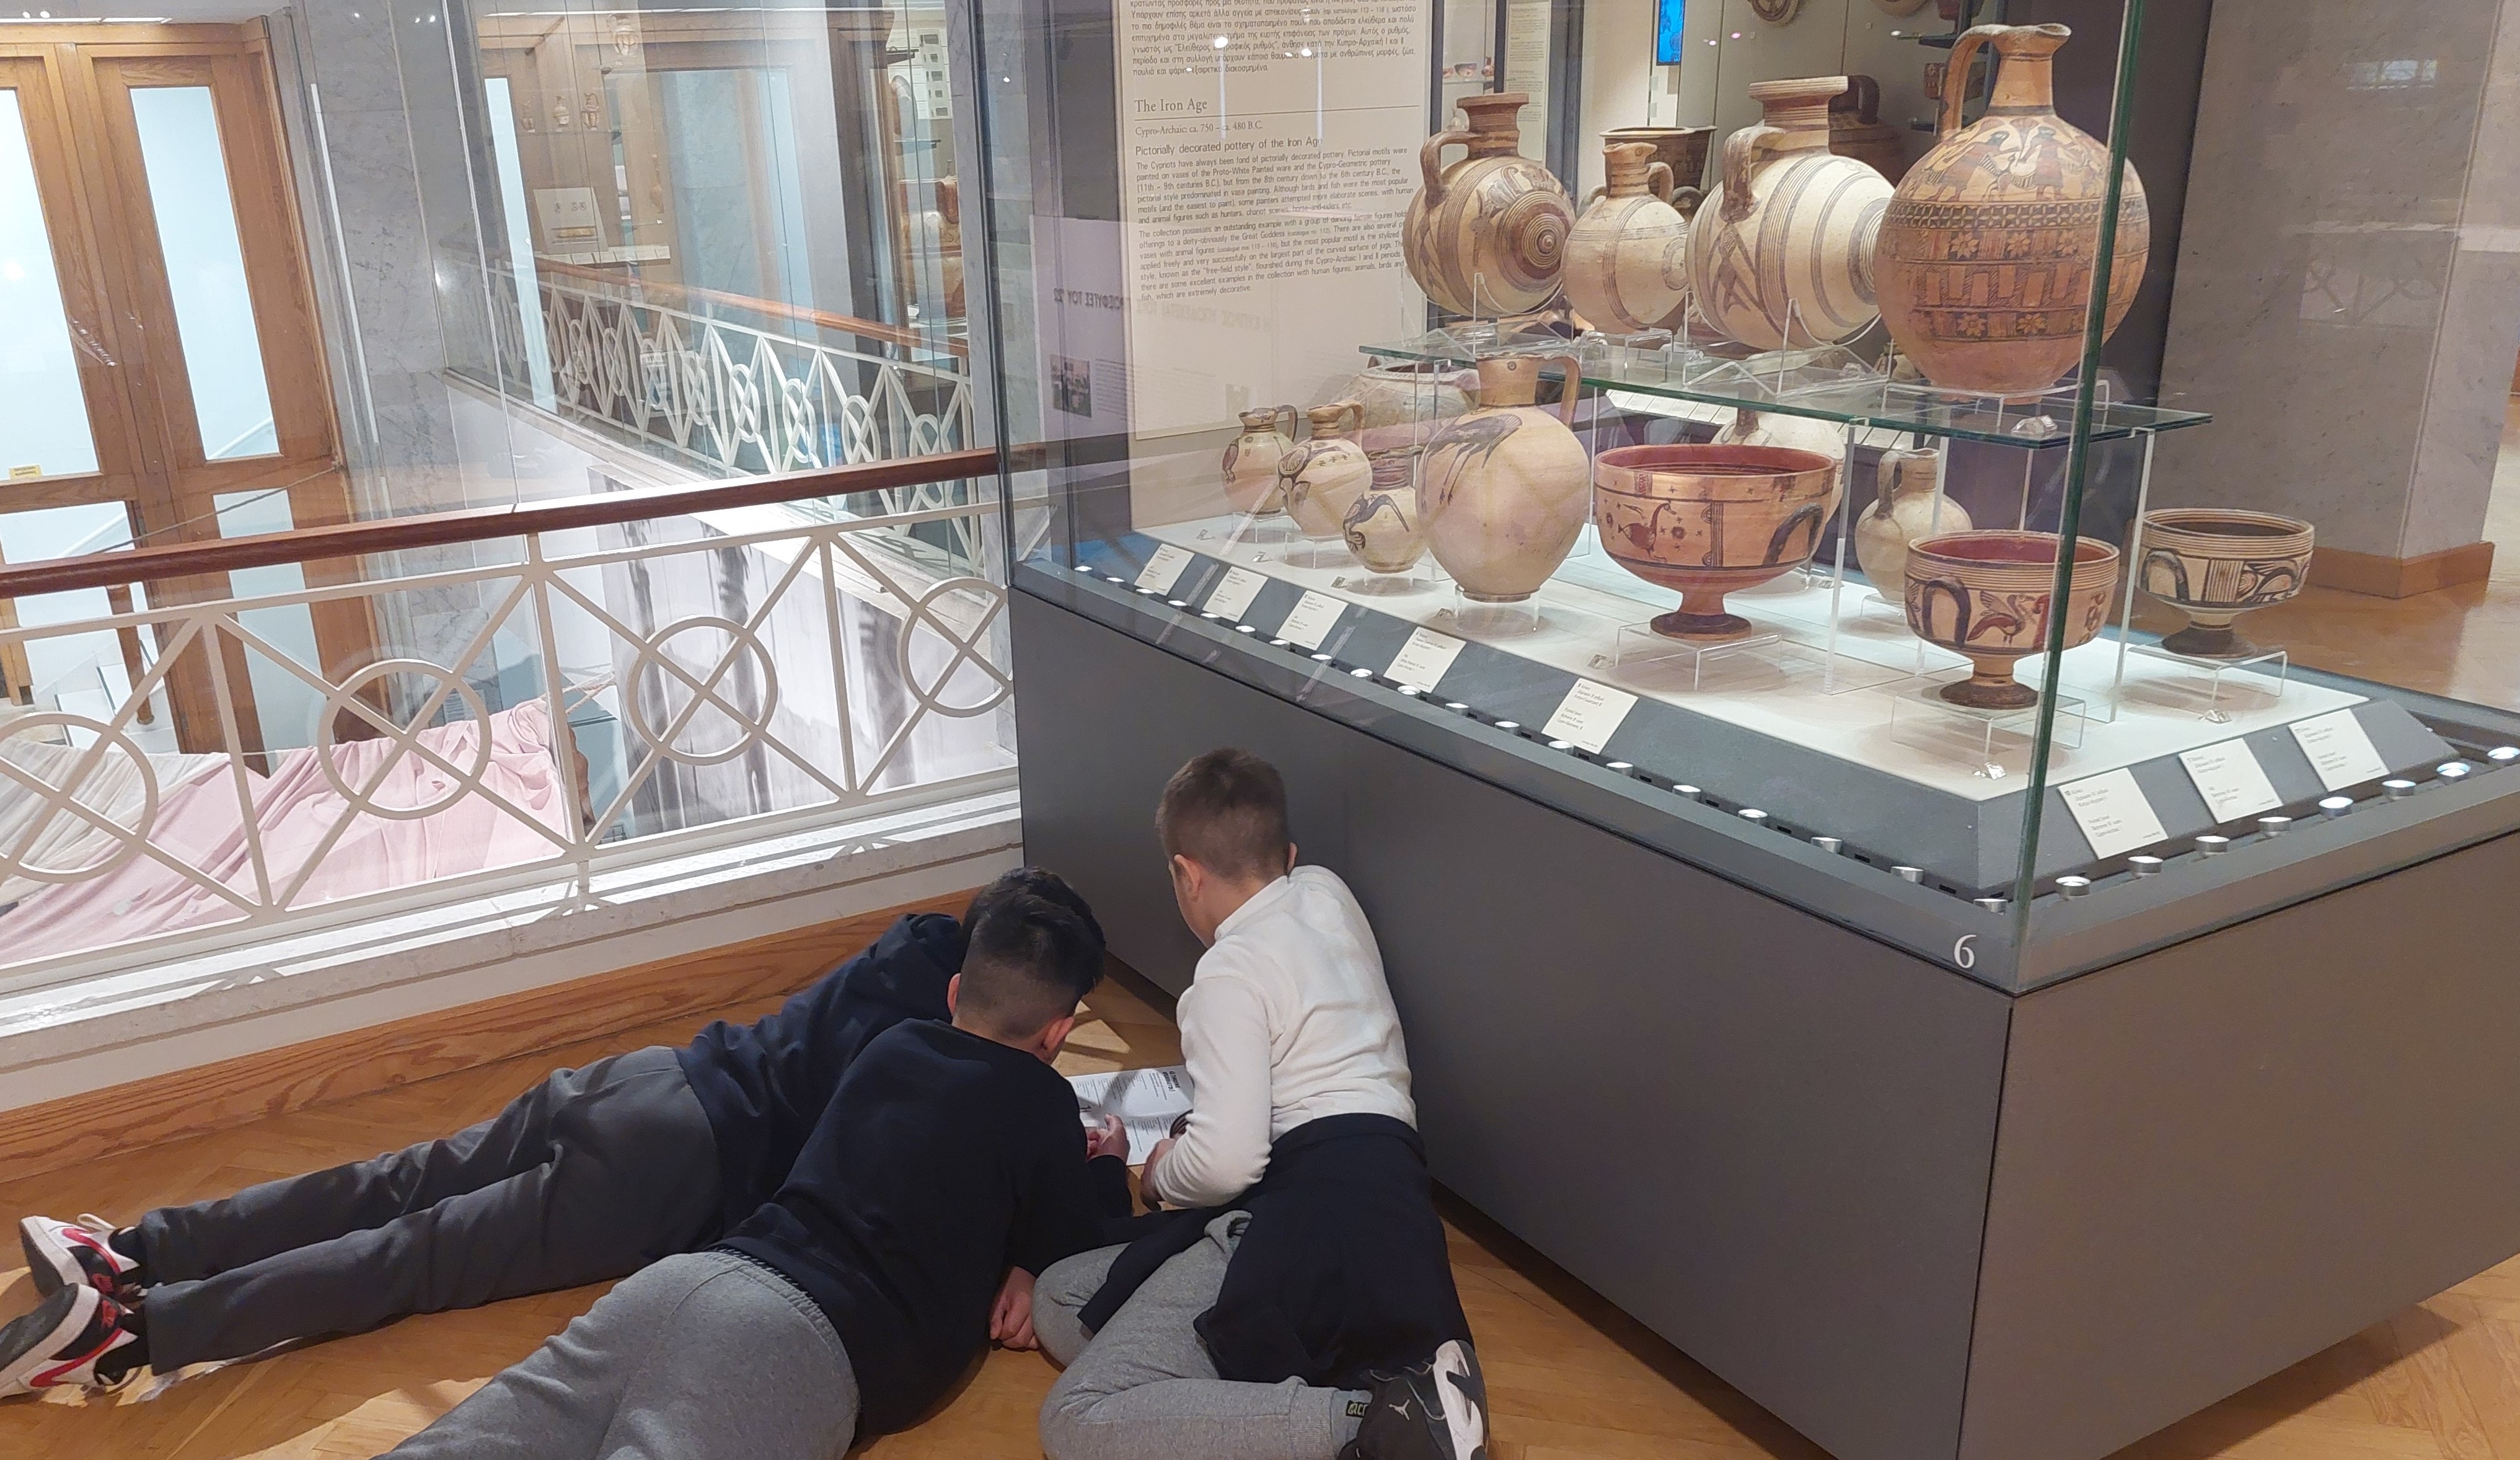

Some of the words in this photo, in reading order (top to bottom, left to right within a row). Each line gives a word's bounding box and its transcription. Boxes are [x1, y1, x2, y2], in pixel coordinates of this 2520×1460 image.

[1132, 11, 1163, 19] Υπάρχουν
[1166, 10, 1186, 19] επίσης
[1189, 9, 1210, 19] αρκετά
[1233, 8, 1253, 17] αγγεία
[1155, 20, 1186, 30] δημοφιλές
[1190, 20, 1204, 29] θέμα
[1132, 45, 1160, 54] γνωστός
[1186, 54, 1212, 63] συλλογή
[1134, 99, 1156, 112] The
[1161, 99, 1183, 111] Iron
[1187, 98, 1207, 113] Age
[1201, 123, 1213, 132] 750
[1233, 122, 1245, 130] 480
[1248, 121, 1262, 129] B.C.
[1136, 144, 1174, 156] Pictorially
[1179, 141, 1221, 153] decorated
[1225, 142, 1254, 153] pottery
[1259, 139, 1267, 149] of
[1271, 138, 1284, 148] the
[1288, 138, 1302, 147] Iron
[1151, 161, 1176, 170] Cypriots
[1196, 159, 1217, 167] always
[1237, 156, 1249, 164] fond
[1261, 154, 1288, 164] pictorially
[1292, 151, 1321, 161] decorated
[1137, 172, 1159, 182] painted
[1213, 167, 1249, 176] Proto-White
[1370, 159, 1391, 167] pottery
[1138, 194, 1161, 203] pictorial
[1164, 193, 1178, 201] style
[1274, 184, 1299, 193] Although
[1388, 177, 1408, 186] popular
[1164, 182, 1174, 190] 9th
[1177, 180, 1203, 189] centuries
[1139, 205, 1156, 213] motifs
[1256, 198, 1279, 206] painters
[1174, 214, 1192, 222] figures
[1183, 227, 1211, 236] possesses
[1223, 222, 1256, 231] outstanding
[1259, 220, 1282, 228] example
[1305, 217, 1320, 226] group
[1375, 212, 1392, 220] figures
[1344, 234, 1357, 242] motif
[1381, 250, 1400, 260] periods
[1140, 261, 1161, 270] applied
[1190, 278, 1215, 286] excellent
[1218, 275, 1245, 283] examples
[1156, 291, 1173, 299] which
[1188, 288, 1217, 297] extremely
[1954, 934, 1977, 968] 6
